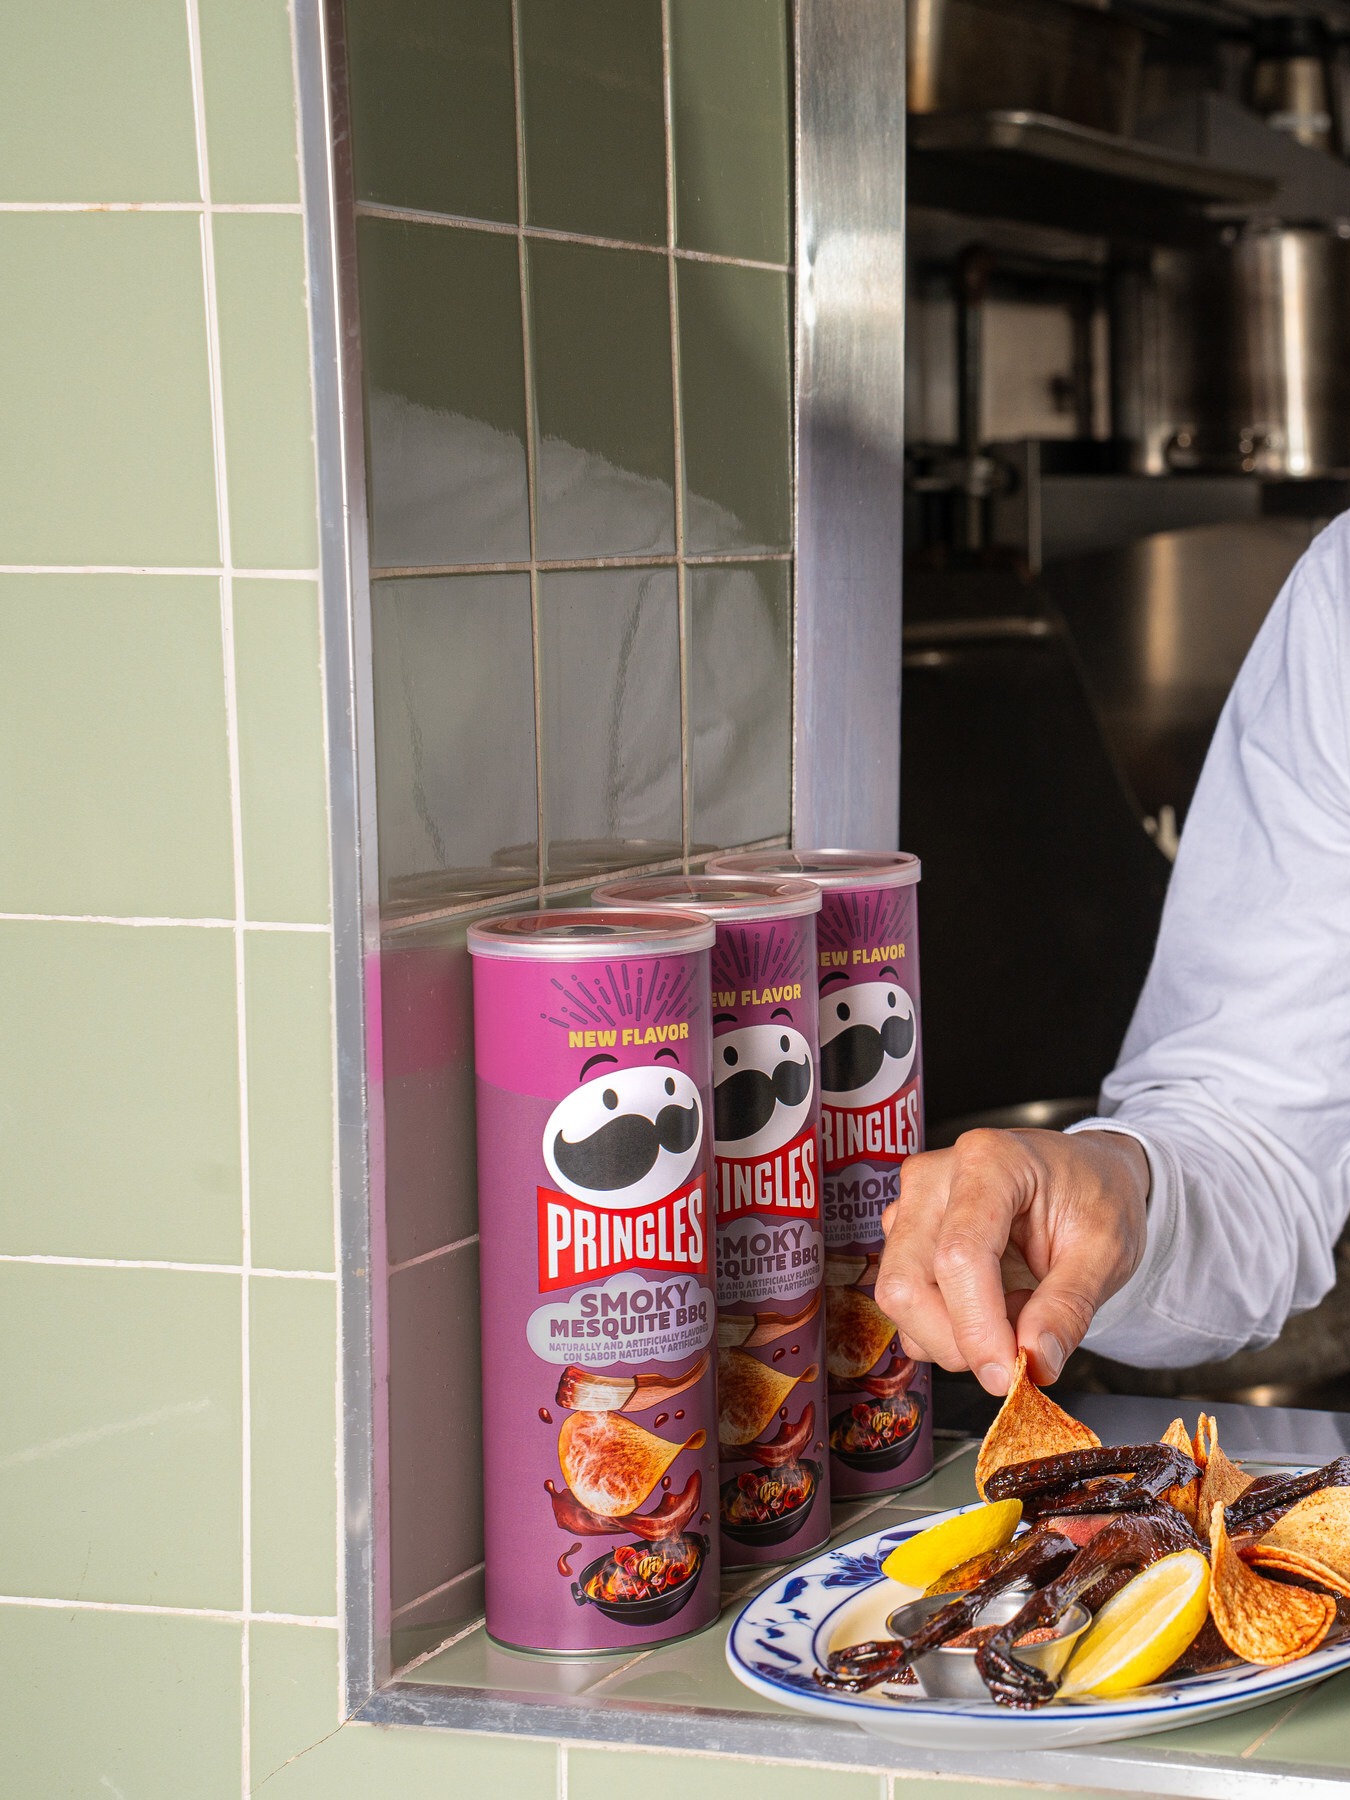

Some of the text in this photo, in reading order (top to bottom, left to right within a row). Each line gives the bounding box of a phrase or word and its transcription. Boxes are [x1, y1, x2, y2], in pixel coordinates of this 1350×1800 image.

[817, 943, 906, 967] EW FLAVOR
[741, 983, 802, 1006] FLAVOR
[568, 1022, 689, 1048] NEW FLAVOR
[822, 1089, 919, 1162] RINGLES
[715, 1138, 815, 1214] INGLES
[823, 1174, 900, 1204] SMOK
[547, 1188, 704, 1279] PRINGLES
[853, 1229, 884, 1240] NATURA
[791, 1243, 819, 1269] BBQ
[726, 1281, 745, 1291] AND
[746, 1272, 795, 1289] ARTIFICIALLY
[740, 1285, 777, 1299] NATURAL
[580, 1281, 691, 1318] SMOKY
[550, 1301, 707, 1340] MESQUITE BBQ
[549, 1322, 709, 1352] NATURALLY AND ARTIFICIALLY FLAVORED
[563, 1335, 702, 1362] CON SABOR NATURAL Y ARTIFICIAL
